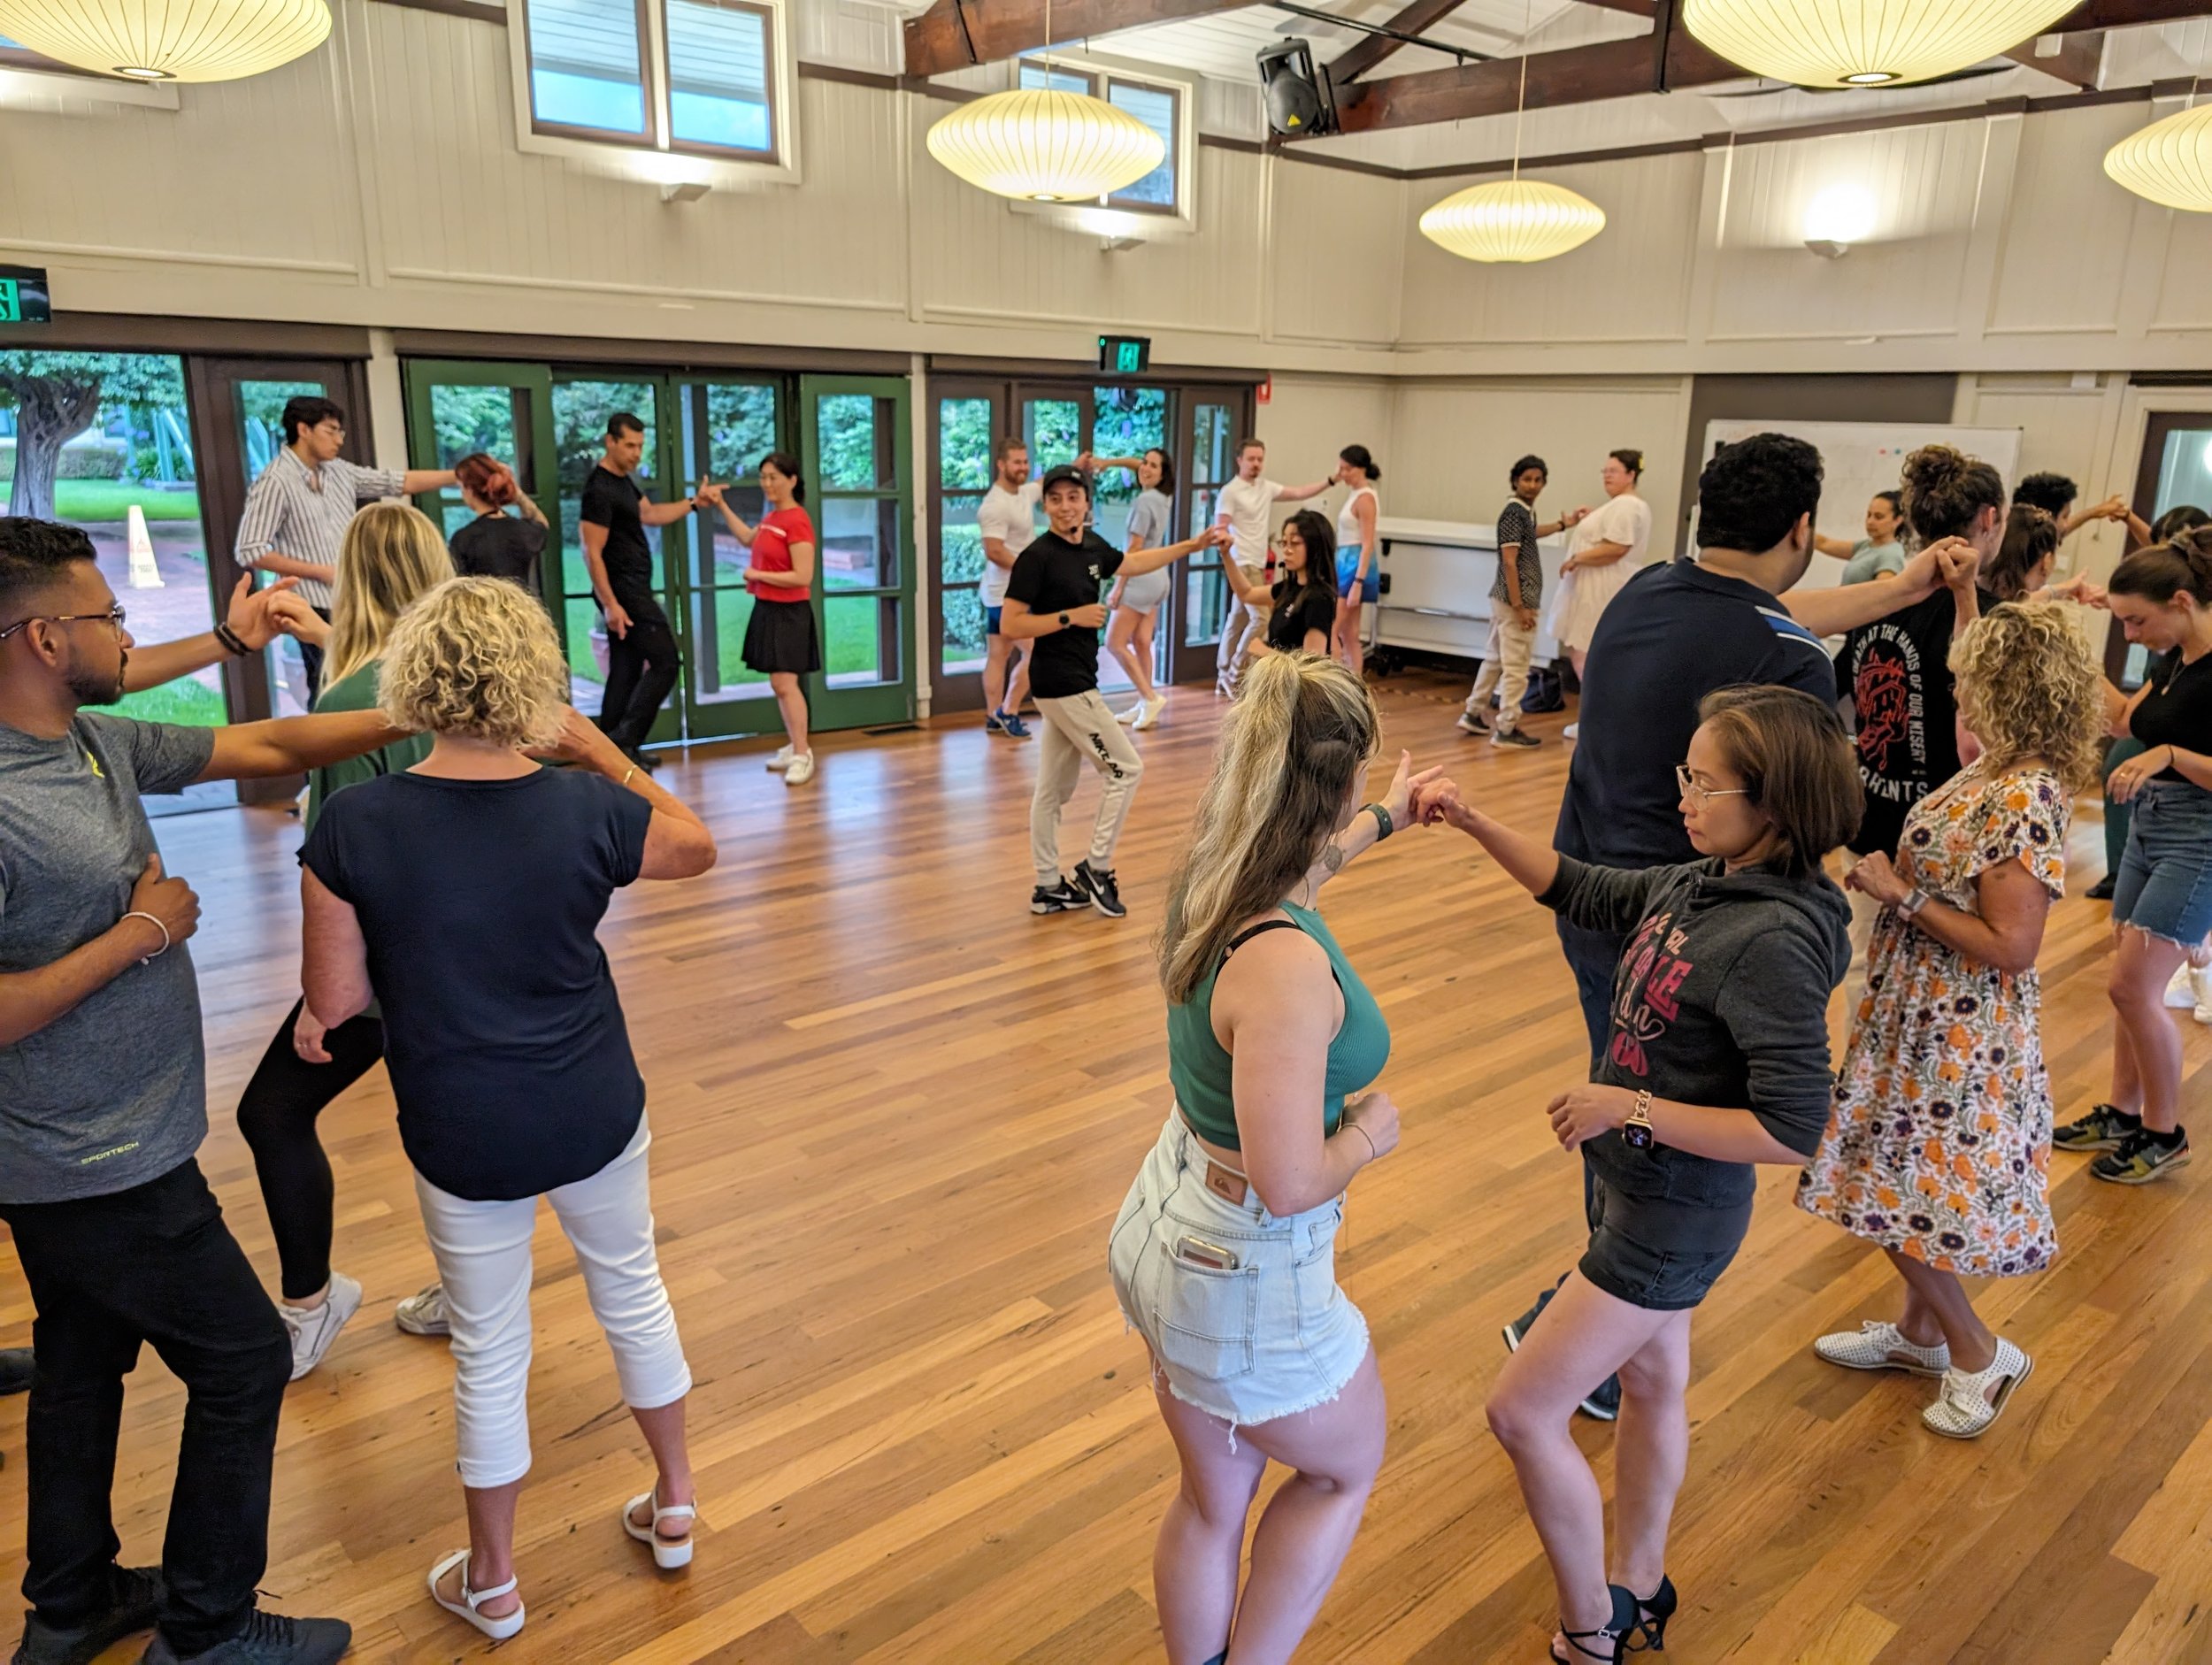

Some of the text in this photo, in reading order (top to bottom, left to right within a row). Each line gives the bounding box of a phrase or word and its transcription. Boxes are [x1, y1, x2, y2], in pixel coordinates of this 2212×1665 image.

[1868, 625, 1879, 644] AT
[1879, 624, 1900, 642] THE
[1896, 630, 1920, 672] HANDS
[1909, 673, 1923, 692] OF
[1908, 694, 1924, 718] OUR
[1909, 720, 1927, 765] MISERY
[1088, 733, 1124, 779] NIKE AR
[81, 1140, 140, 1165] SPORTECH
